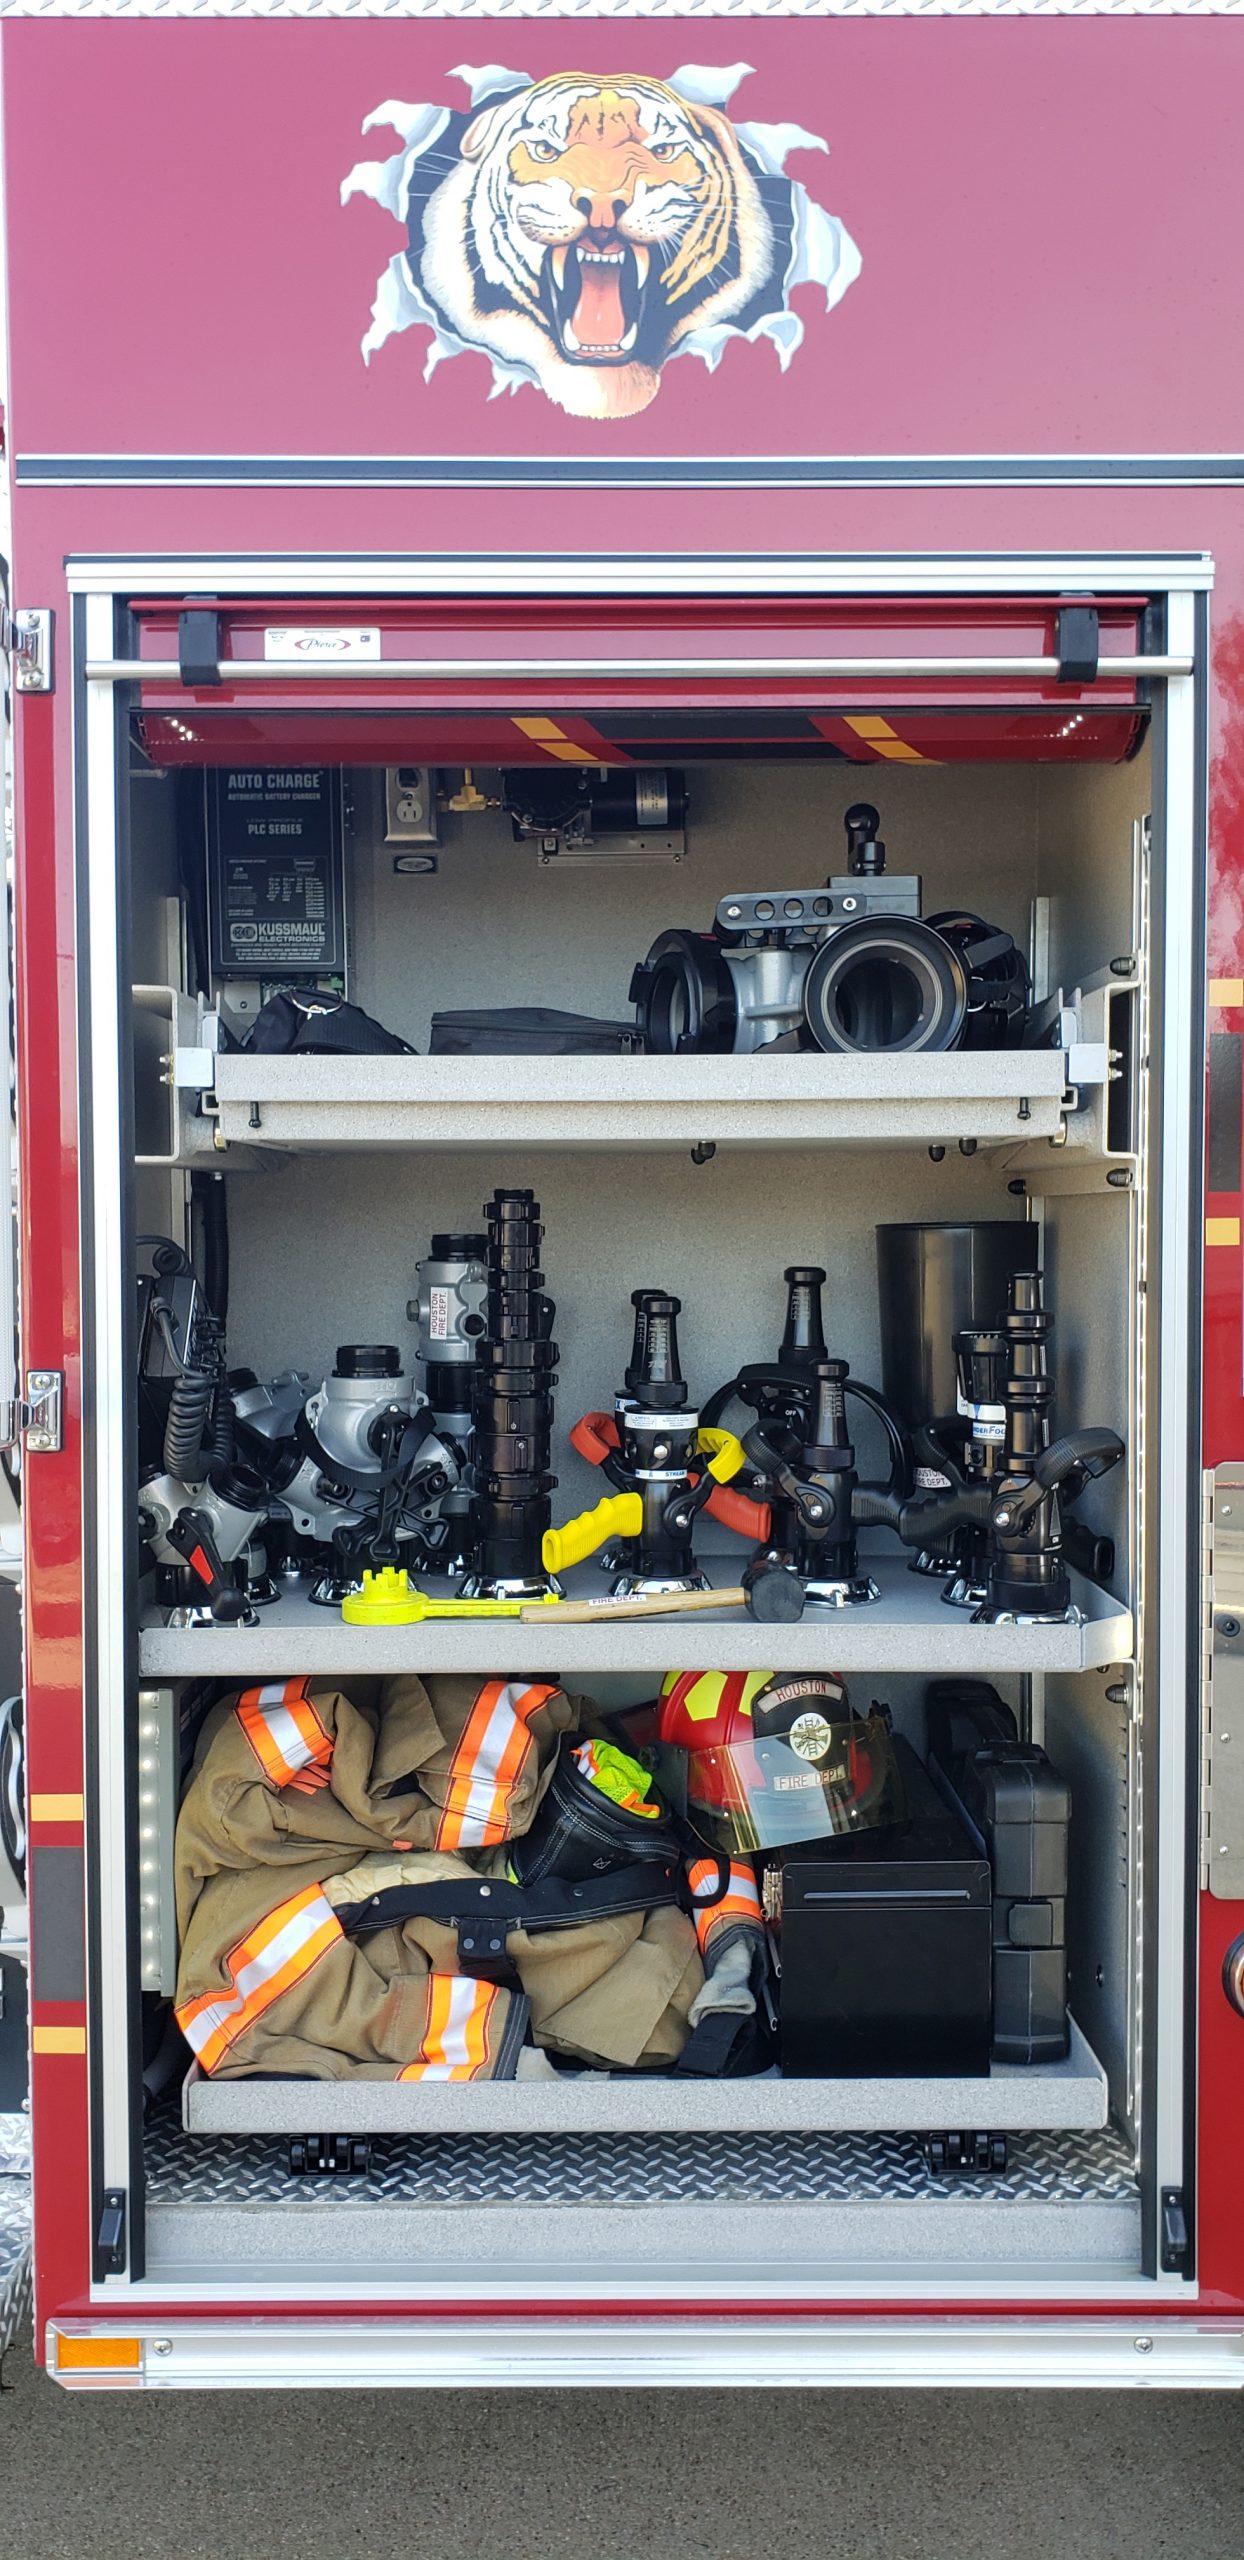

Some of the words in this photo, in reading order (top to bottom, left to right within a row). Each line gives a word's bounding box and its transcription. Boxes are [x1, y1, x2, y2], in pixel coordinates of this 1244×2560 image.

[228, 774, 263, 789] AUTO
[266, 773, 321, 789] CHARGE
[228, 793, 264, 801] AUTOMATIC
[264, 793, 292, 801] BATTERY
[292, 793, 321, 801] CHARGER
[248, 824, 266, 835] PLC
[268, 824, 302, 835] SERIES
[258, 922, 325, 936] KUSSMAUL
[258, 935, 326, 943] ELECTRONICS
[438, 1291, 447, 1316] DEPT.
[431, 1293, 439, 1334] HOUSTON
[438, 1317, 446, 1336] FIRE
[927, 1477, 948, 1487] DEPT.
[775, 1680, 827, 1702] HOUSTON
[779, 1775, 809, 1789] FIRE
[815, 1767, 843, 1785] DEPT.
